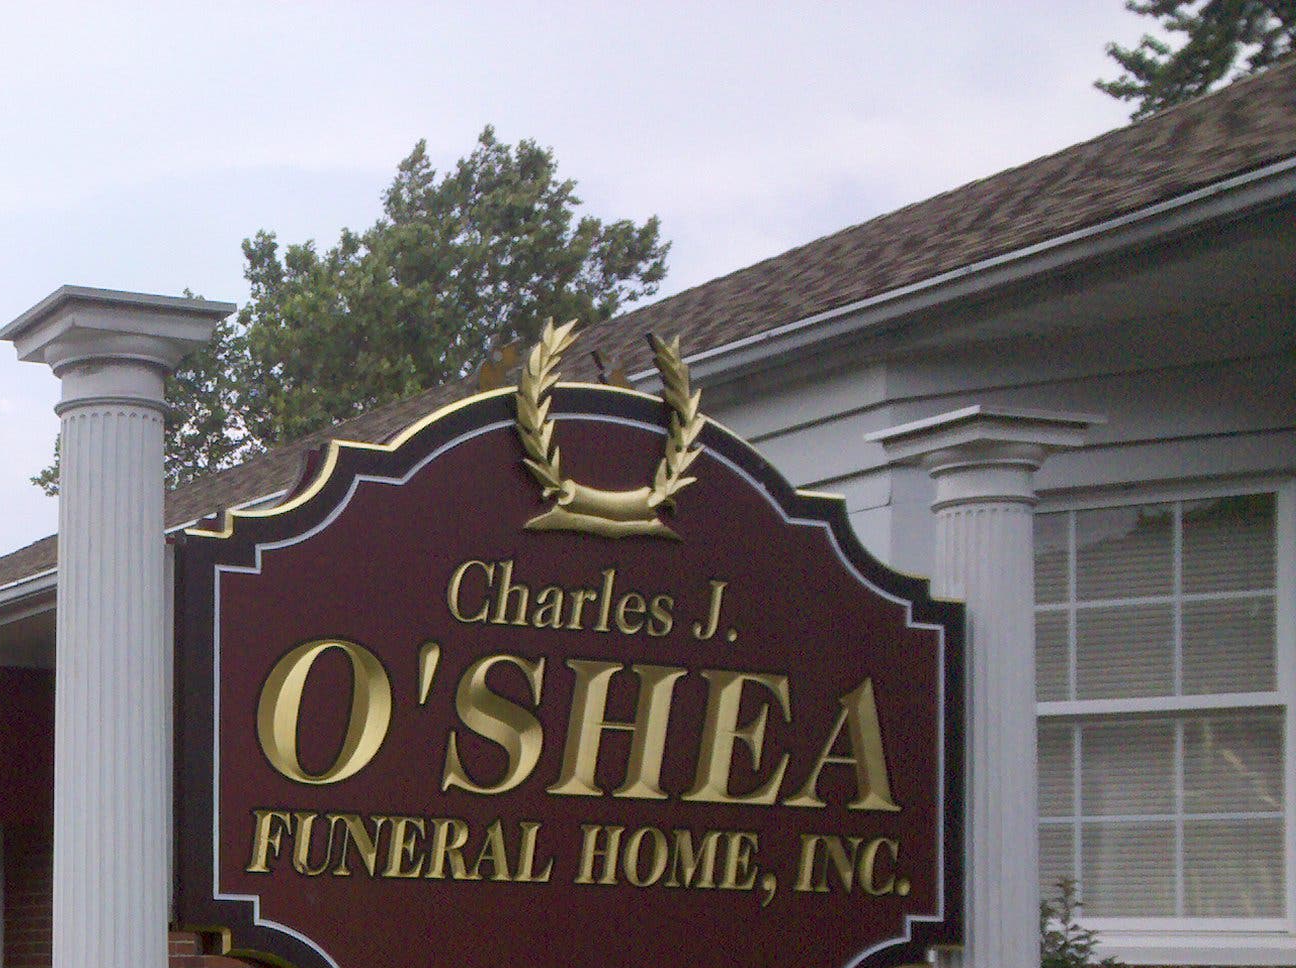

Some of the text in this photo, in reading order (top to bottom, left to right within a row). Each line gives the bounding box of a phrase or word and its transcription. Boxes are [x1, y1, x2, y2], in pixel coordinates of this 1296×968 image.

[446, 560, 740, 643] Charles J.
[256, 638, 903, 814] O'SHEA
[245, 808, 913, 908] FUNERAL HOME, INC.
